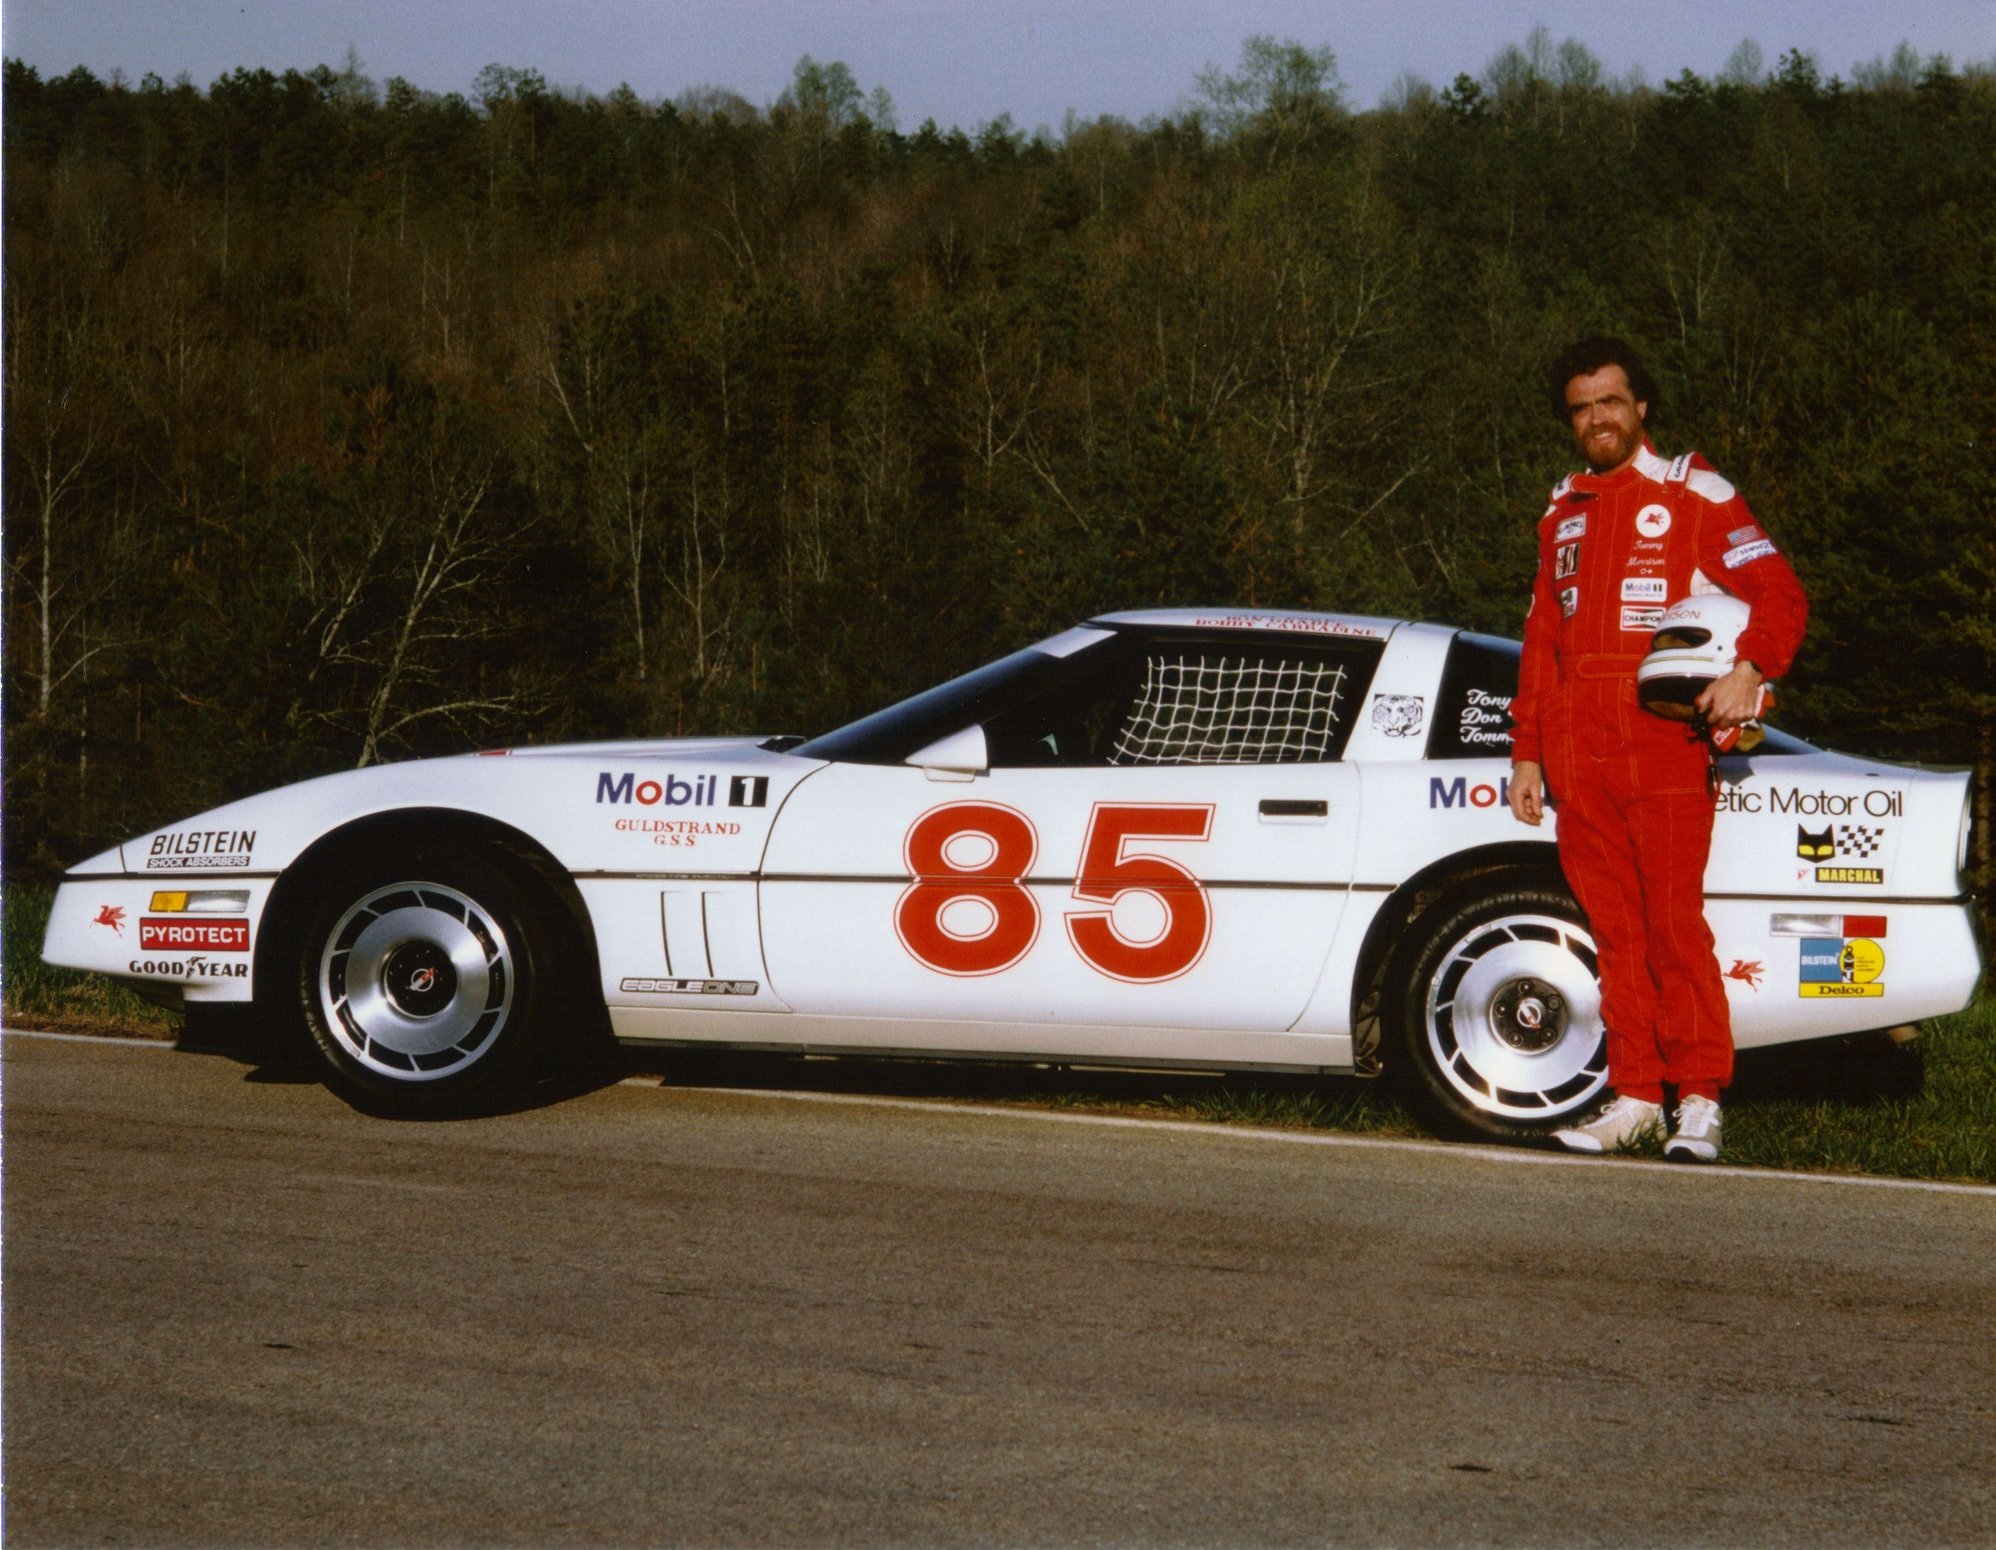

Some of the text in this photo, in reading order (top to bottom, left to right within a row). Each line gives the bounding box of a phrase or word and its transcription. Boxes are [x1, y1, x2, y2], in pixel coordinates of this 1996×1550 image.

[1625, 583, 1651, 592] Mobil
[1466, 688, 1512, 710] Tony
[1460, 706, 1503, 725] Don
[596, 772, 717, 807] Mobil
[1714, 785, 1903, 817] etic Motor Oil
[614, 819, 741, 835] GULDSTRAND
[150, 830, 257, 856] BILSTEIN
[149, 856, 248, 868] SHOCK ABSORBERS
[1817, 868, 1882, 883] MARCHAL
[893, 800, 1216, 985] 85
[142, 925, 247, 944] PYROTECT
[1818, 985, 1865, 995] Delco
